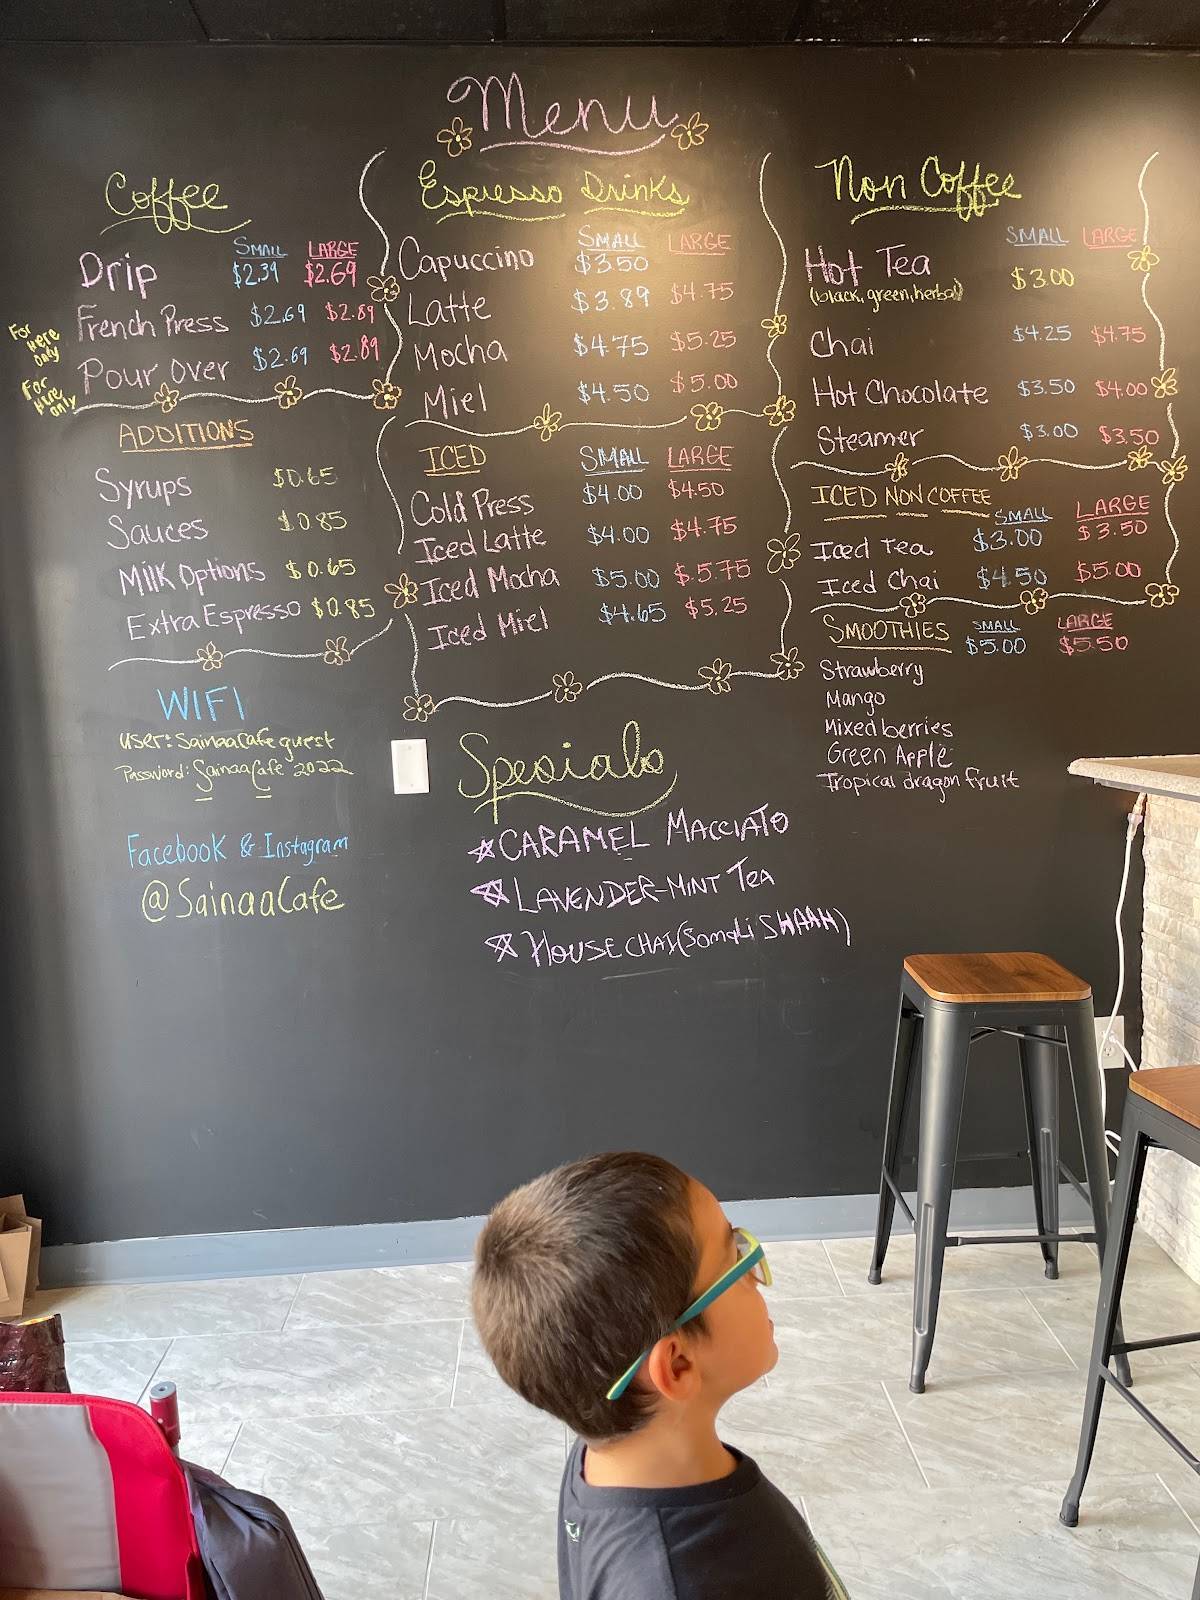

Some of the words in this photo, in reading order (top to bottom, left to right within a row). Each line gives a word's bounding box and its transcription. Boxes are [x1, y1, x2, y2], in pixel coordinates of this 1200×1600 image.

[447, 72, 679, 139] Menu
[105, 171, 228, 234] Coffee
[418, 160, 563, 217] Espresso
[580, 170, 691, 206] Drinks
[814, 155, 906, 202] Non
[920, 156, 1022, 222] Coffee
[233, 236, 288, 257] SMALL
[308, 241, 360, 258] LARGE
[577, 224, 646, 249] SMALL
[668, 231, 732, 252] LARGE
[1006, 226, 1069, 244] SMALL
[1082, 226, 1138, 247] LARGE
[232, 261, 279, 288] $2.39
[304, 260, 357, 288] $2.69
[399, 236, 535, 282] Capuccino
[574, 250, 649, 276] $3.50
[805, 245, 863, 287] Hot
[876, 243, 932, 278] Tea
[79, 252, 158, 299] Drip
[1011, 266, 1075, 291] $3.00
[407, 290, 492, 327] Latte
[570, 285, 651, 314] $3.89
[670, 281, 736, 305] $4.75
[76, 305, 156, 342] French
[160, 304, 230, 337] Press
[250, 301, 306, 328] $2.69
[325, 301, 375, 324] $2.89
[8, 323, 32, 341] For
[573, 332, 650, 358] $4.75
[669, 330, 737, 353] $5.25
[809, 328, 875, 359] Chai
[1013, 325, 1072, 342] $4.25
[1091, 325, 1146, 347] $4.75
[252, 345, 309, 372] $2.69
[329, 334, 380, 364] $2.89
[414, 334, 509, 371] Mocha
[21, 376, 48, 401] For
[77, 358, 158, 395] Pour
[171, 357, 230, 384] Over
[576, 380, 650, 406] $4.50
[670, 370, 738, 395] $5.00
[1017, 379, 1076, 398] $3.50
[1095, 380, 1148, 400] $4.00
[424, 383, 487, 420] Miel
[812, 376, 857, 408] Hot
[865, 379, 989, 405] Chocolate
[119, 418, 255, 449] ADDITIONS
[817, 424, 925, 456] Steamer
[1020, 423, 1079, 442] $3.00
[1098, 425, 1160, 445] $3.50
[419, 443, 487, 473] ICED
[579, 445, 650, 472] SMALL
[667, 444, 735, 470] LARGE
[95, 467, 192, 510] Syrups
[273, 467, 338, 489] $0.65
[582, 482, 644, 506] $4.00
[668, 478, 726, 500] $4.50
[410, 489, 468, 528] Cold
[475, 487, 536, 521] Press
[811, 485, 877, 507] ICED
[885, 485, 925, 506] NON
[927, 486, 993, 506] COFFEE
[994, 506, 1054, 527] SMALL
[1075, 494, 1151, 521] LARGE
[106, 514, 209, 550] Sauces
[413, 529, 478, 565] Iced
[482, 522, 548, 554] Latte
[587, 523, 651, 547] $4.00
[670, 515, 738, 542] $4.75
[972, 527, 1043, 553] $3.00
[1077, 519, 1149, 542] $3.50
[809, 536, 872, 563] Iced
[880, 537, 935, 558] Tea
[118, 559, 177, 597] Milk
[178, 557, 267, 596] Options
[285, 557, 357, 580] $0.65
[591, 567, 661, 590] $5.00
[818, 567, 877, 597] Iced
[886, 568, 941, 592] Chai
[975, 565, 1049, 591] $4.50
[1073, 560, 1143, 585] $5.00
[420, 567, 481, 607] Iced
[486, 562, 562, 593] Mocha
[126, 610, 199, 641] Extra
[202, 600, 301, 635] Espresso
[310, 596, 376, 620] $0.85
[598, 602, 668, 626] $4.65
[684, 596, 750, 620] $5.25
[972, 619, 1022, 632] SMALL
[1057, 612, 1114, 632] LARGE
[427, 612, 489, 651] Iced
[497, 606, 551, 640] Miel
[822, 614, 950, 645] SMOOTHIES
[965, 635, 1027, 656] $5.00
[1058, 635, 1130, 656] $5.50
[819, 656, 924, 685] Strawberry
[157, 685, 246, 721] WIFI
[825, 690, 886, 716] Mango
[824, 719, 877, 738] Mixed
[881, 715, 954, 739] berries
[278, 730, 336, 763] guest
[827, 741, 886, 766] Green
[895, 741, 954, 769] Apple
[113, 764, 191, 783] Password:
[293, 759, 355, 778] 2022
[815, 772, 897, 797] Tropical
[902, 771, 961, 803] dragon
[965, 767, 1020, 790] fruit
[128, 832, 228, 869] Facebook
[240, 832, 256, 857] &
[259, 832, 350, 867] Instagram
[498, 820, 650, 862] CARAMEL
[512, 872, 720, 914] LAVENDER-MINT
[520, 928, 623, 967] HOUSE
